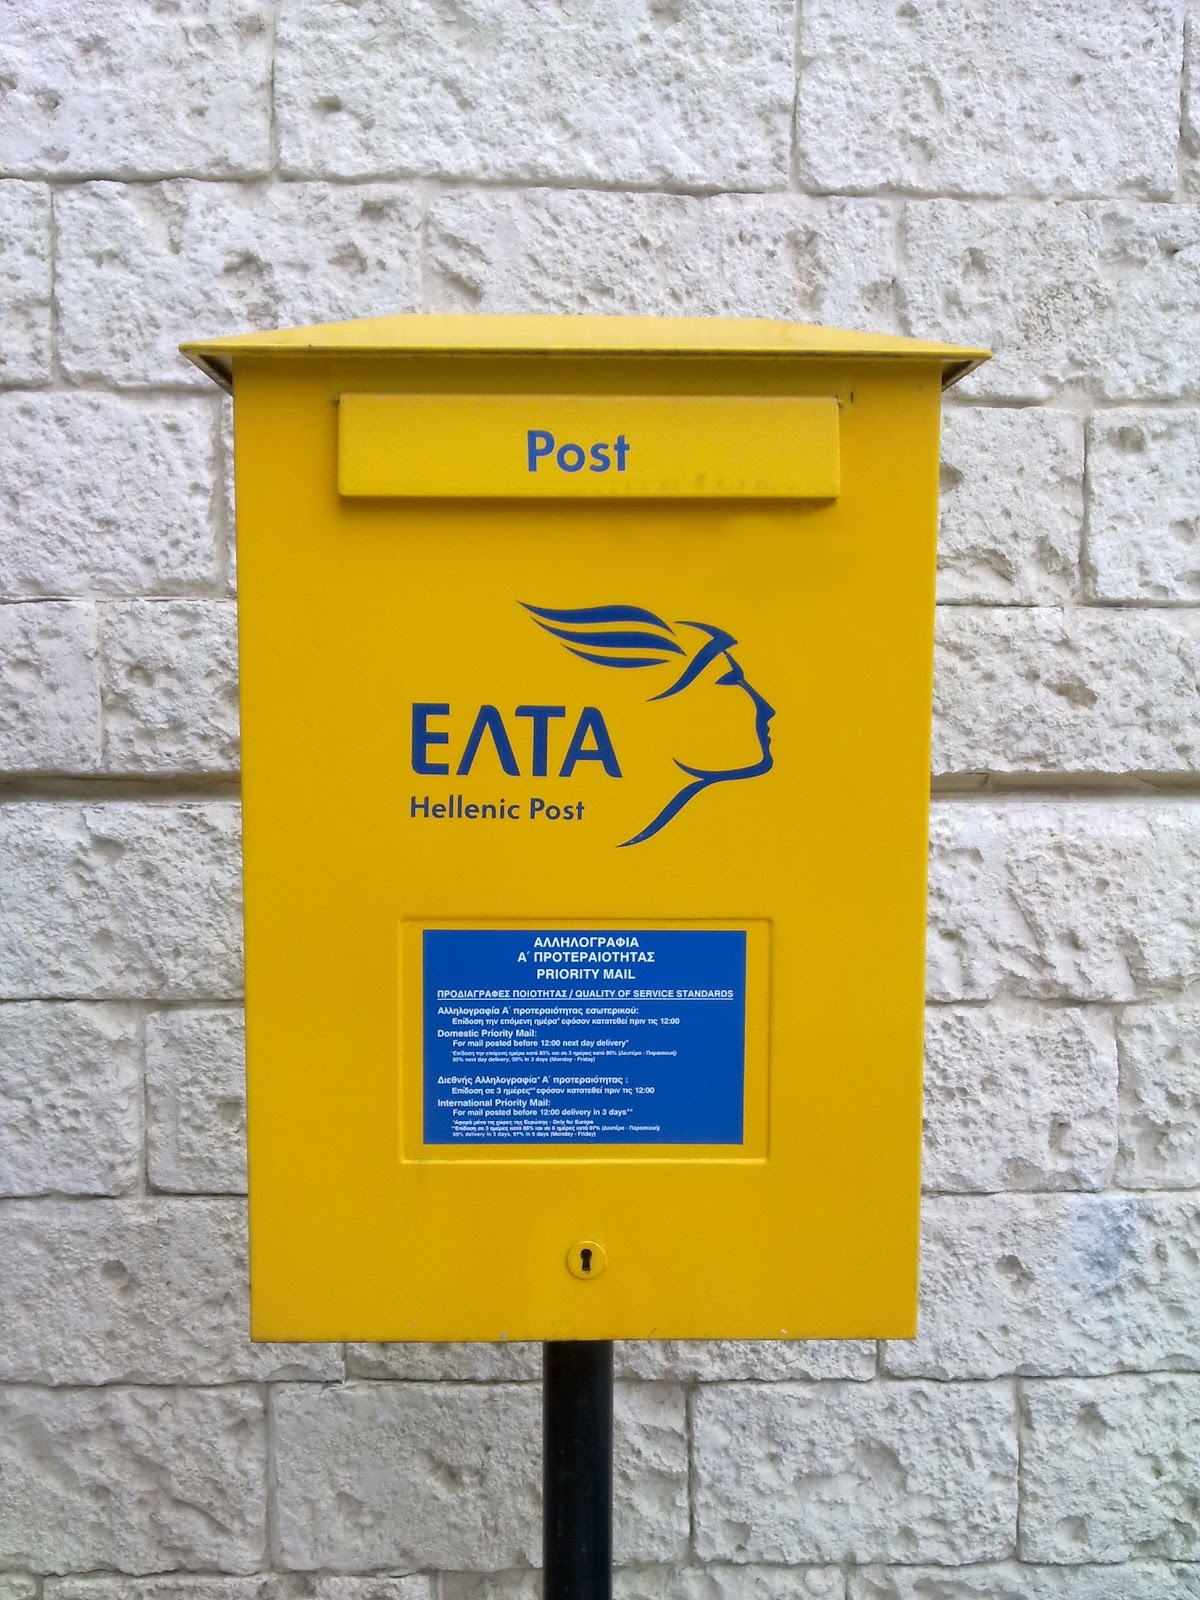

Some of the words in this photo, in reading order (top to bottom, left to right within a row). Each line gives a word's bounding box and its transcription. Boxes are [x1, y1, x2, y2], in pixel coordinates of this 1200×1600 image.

[527, 429, 631, 473] Post
[411, 703, 623, 778] ΕΛΤΑ
[410, 794, 520, 820] Hellenic
[530, 794, 585, 820] Post
[533, 936, 640, 948] ΑΛΛΗΛΟΓΡΑΦΙΑ
[533, 951, 656, 963] ΠΡΟΤΕΡΑΙΟΤΗΤΑΣ
[536, 968, 600, 980] PRIORITY
[603, 968, 636, 980] MAIL
[437, 989, 510, 998] ΠΡΟΔΙΑΓΡΑΦΕΣ
[512, 989, 567, 998] ΠΟΙΟΤΗΤΑΣ
[575, 989, 616, 998] QUALITY
[617, 989, 631, 998] OF
[633, 989, 674, 998] SERVICE
[676, 989, 734, 998] STANDARDS
[437, 1006, 500, 1016] Αλληλογραφία
[513, 1006, 583, 1016] προτεραιότητας
[585, 1006, 639, 1016] εσωτερικού:
[452, 1017, 484, 1026] Επίδοση
[486, 1017, 498, 1026] την
[500, 1017, 532, 1026] επόμενη
[561, 1017, 589, 1026] εφόσον
[592, 1017, 628, 1026] κατατεθεί
[629, 1017, 645, 1026] πριν
[648, 1017, 658, 1026] τις
[660, 1017, 680, 1026] 12:00
[437, 1029, 479, 1039] Domestic
[481, 1029, 513, 1039] Priority
[515, 1029, 537, 1039] Mail:
[452, 1039, 466, 1048] For
[467, 1039, 483, 1048] mail
[485, 1039, 511, 1048] posted
[513, 1039, 538, 1048] before
[540, 1039, 561, 1048] 12:00
[562, 1039, 579, 1048] next
[580, 1039, 595, 1048] day
[437, 1076, 473, 1085] Διεθνής
[553, 1076, 623, 1085] προτεραιότητας
[452, 1087, 484, 1095] Επίδοση
[485, 1087, 495, 1095] σε
[496, 1087, 502, 1095] 3
[536, 1087, 565, 1095] εφόσον
[566, 1087, 603, 1095] κατατεθεί
[604, 1087, 620, 1095] πριν
[622, 1087, 633, 1095] τις
[635, 1087, 655, 1095] 12:00
[437, 1098, 492, 1108] International
[495, 1098, 527, 1108] Priority
[529, 1098, 551, 1108] Mail:
[452, 1108, 466, 1117] For
[467, 1108, 483, 1117] mail
[485, 1108, 511, 1117] posted
[513, 1108, 538, 1117] before
[540, 1108, 560, 1117] 12:00
[561, 1108, 591, 1117] delivery
[593, 1108, 600, 1117] in
[602, 1108, 607, 1117] 3
